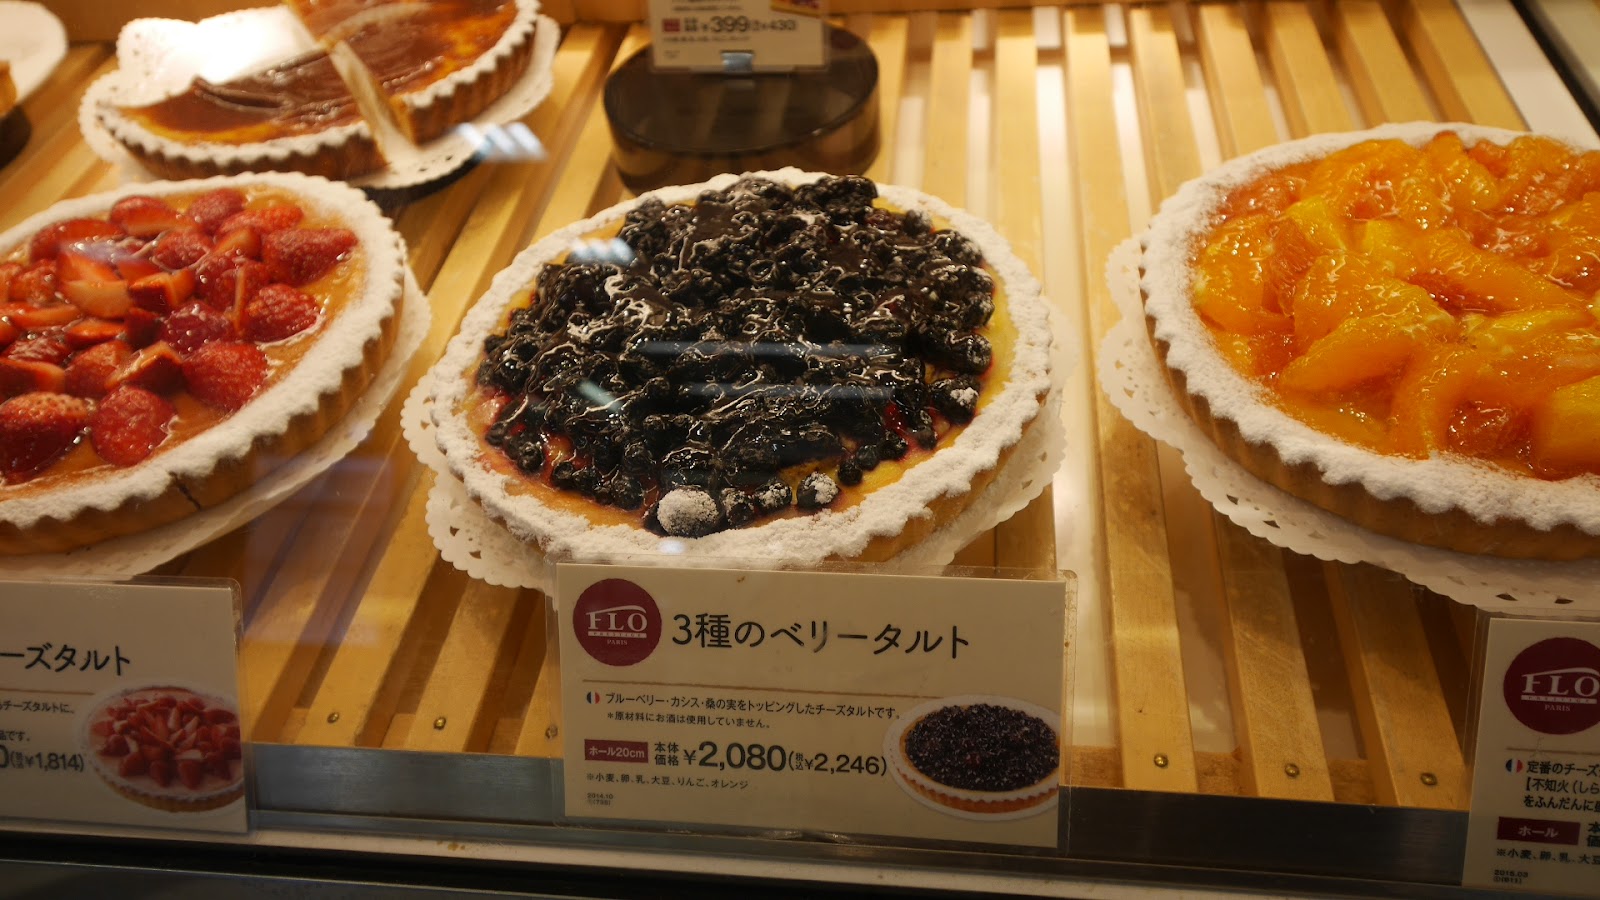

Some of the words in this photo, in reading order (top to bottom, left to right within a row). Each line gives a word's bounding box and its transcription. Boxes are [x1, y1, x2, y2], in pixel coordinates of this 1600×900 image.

[585, 605, 648, 632] FLO
[672, 612, 969, 659] 3種のベリータルト
[1521, 667, 1600, 697] FLO
[0, 700, 75, 714] チーズタルトに、
[1544, 704, 1571, 712] PARIS
[588, 745, 645, 759] ホール20cm
[1526, 761, 1600, 777] 定番のチーズ
[1518, 826, 1559, 838] ホール
